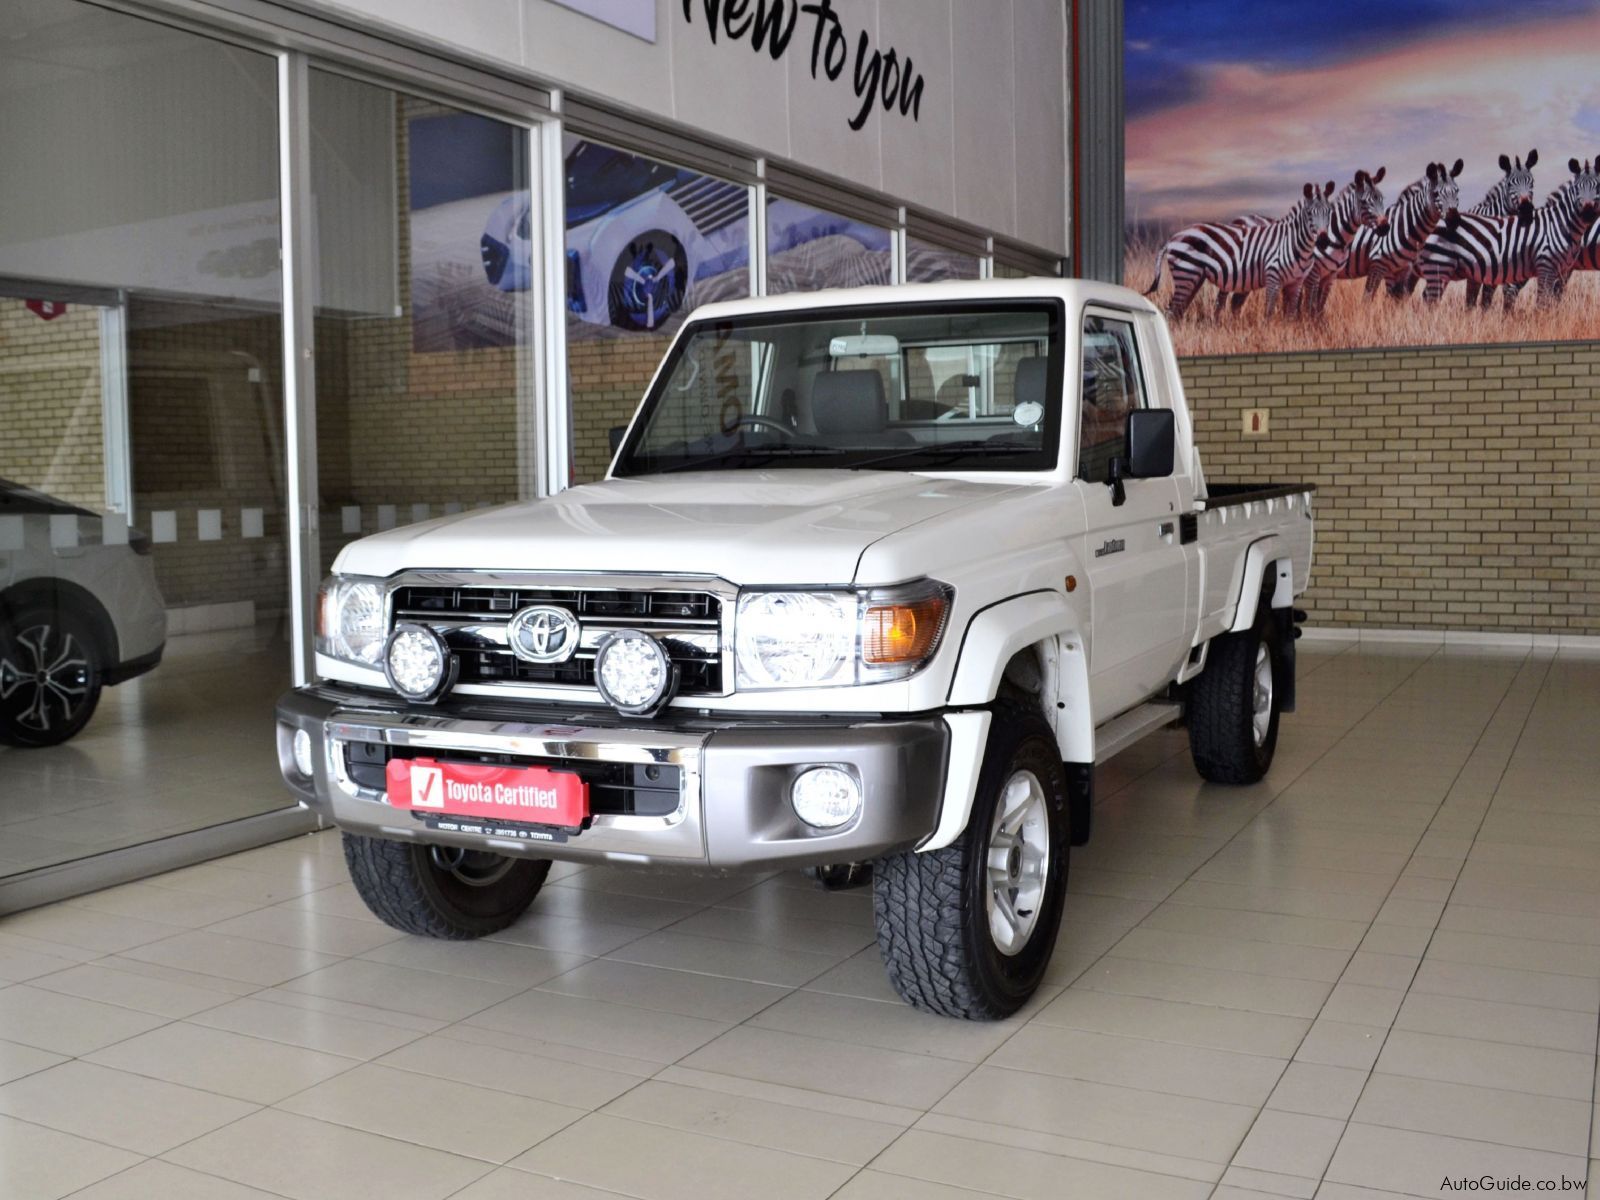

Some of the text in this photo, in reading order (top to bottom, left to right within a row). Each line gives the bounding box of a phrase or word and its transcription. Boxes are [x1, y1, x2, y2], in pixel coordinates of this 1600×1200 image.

[683, 0, 924, 131] New to you
[446, 780, 557, 808] Toyota Certified
